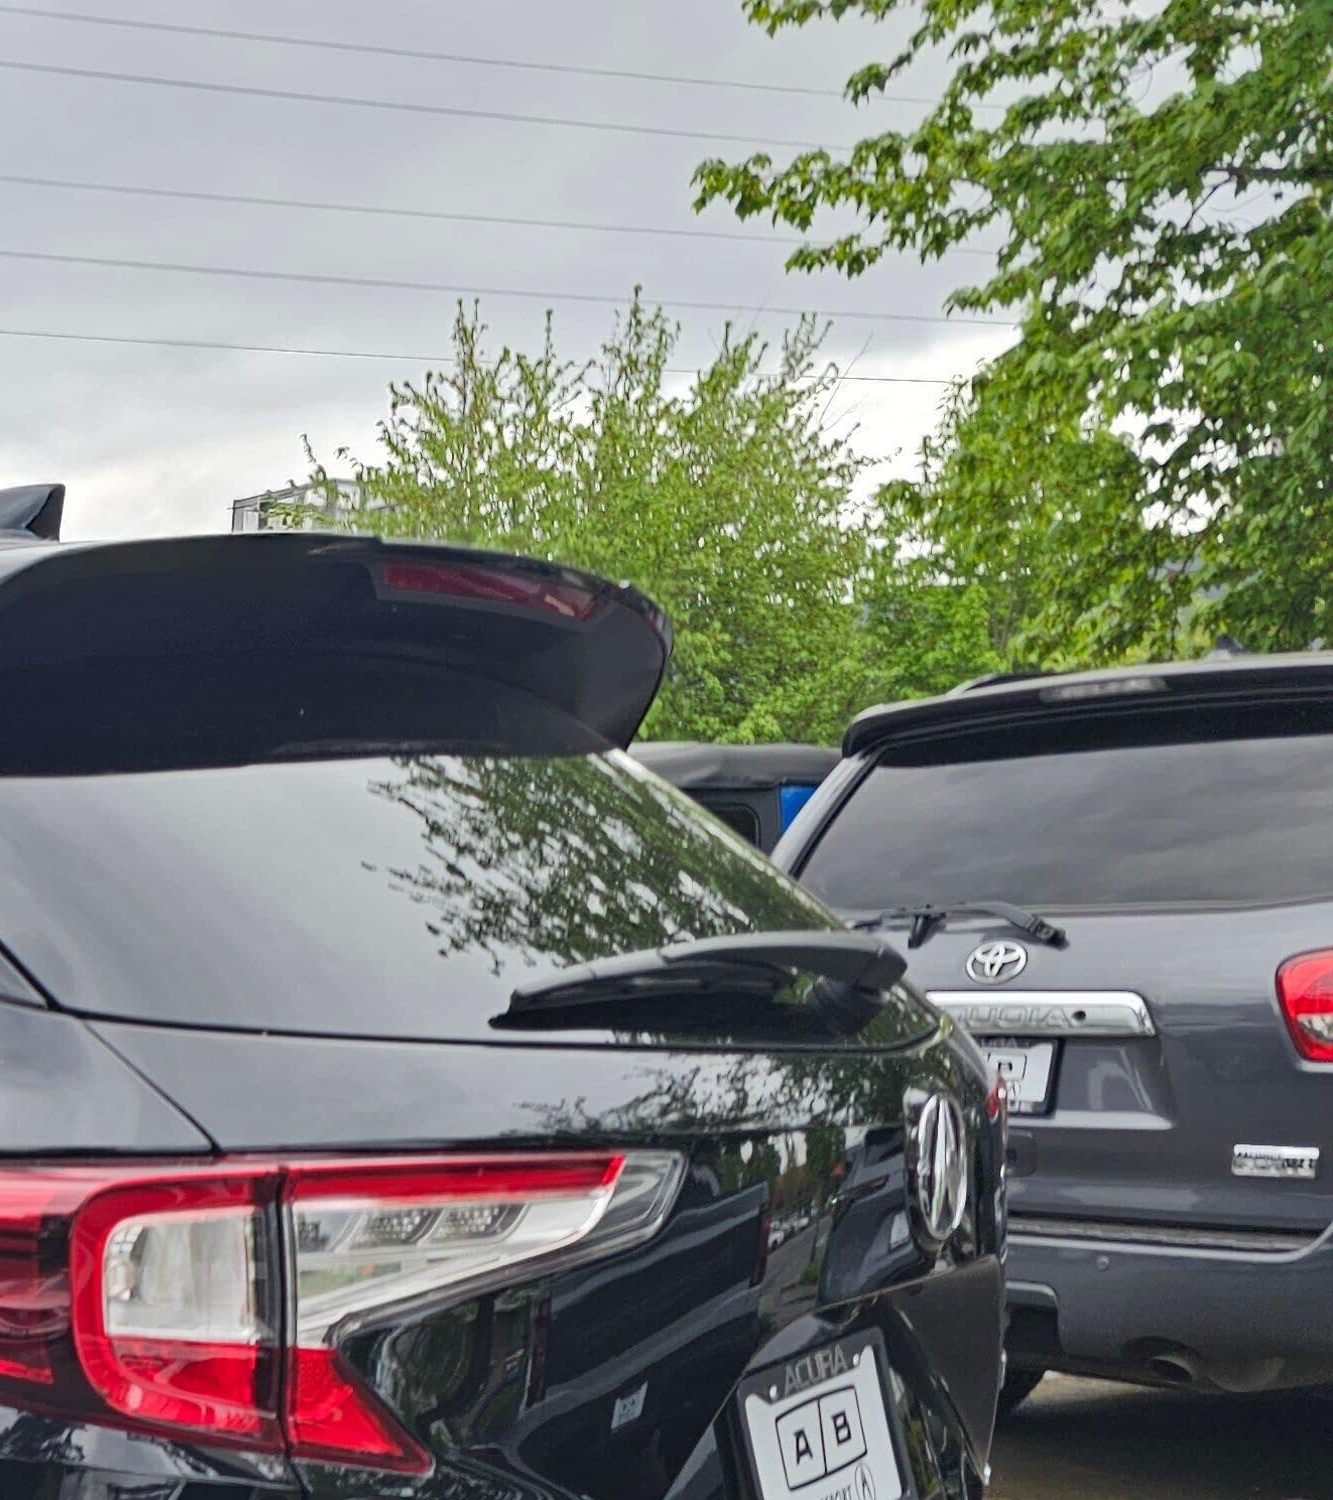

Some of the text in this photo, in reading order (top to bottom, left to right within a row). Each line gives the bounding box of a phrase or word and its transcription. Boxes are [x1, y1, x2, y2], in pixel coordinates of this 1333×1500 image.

[784, 1344, 848, 1397] ACURA
[793, 1410, 852, 1466] A B
